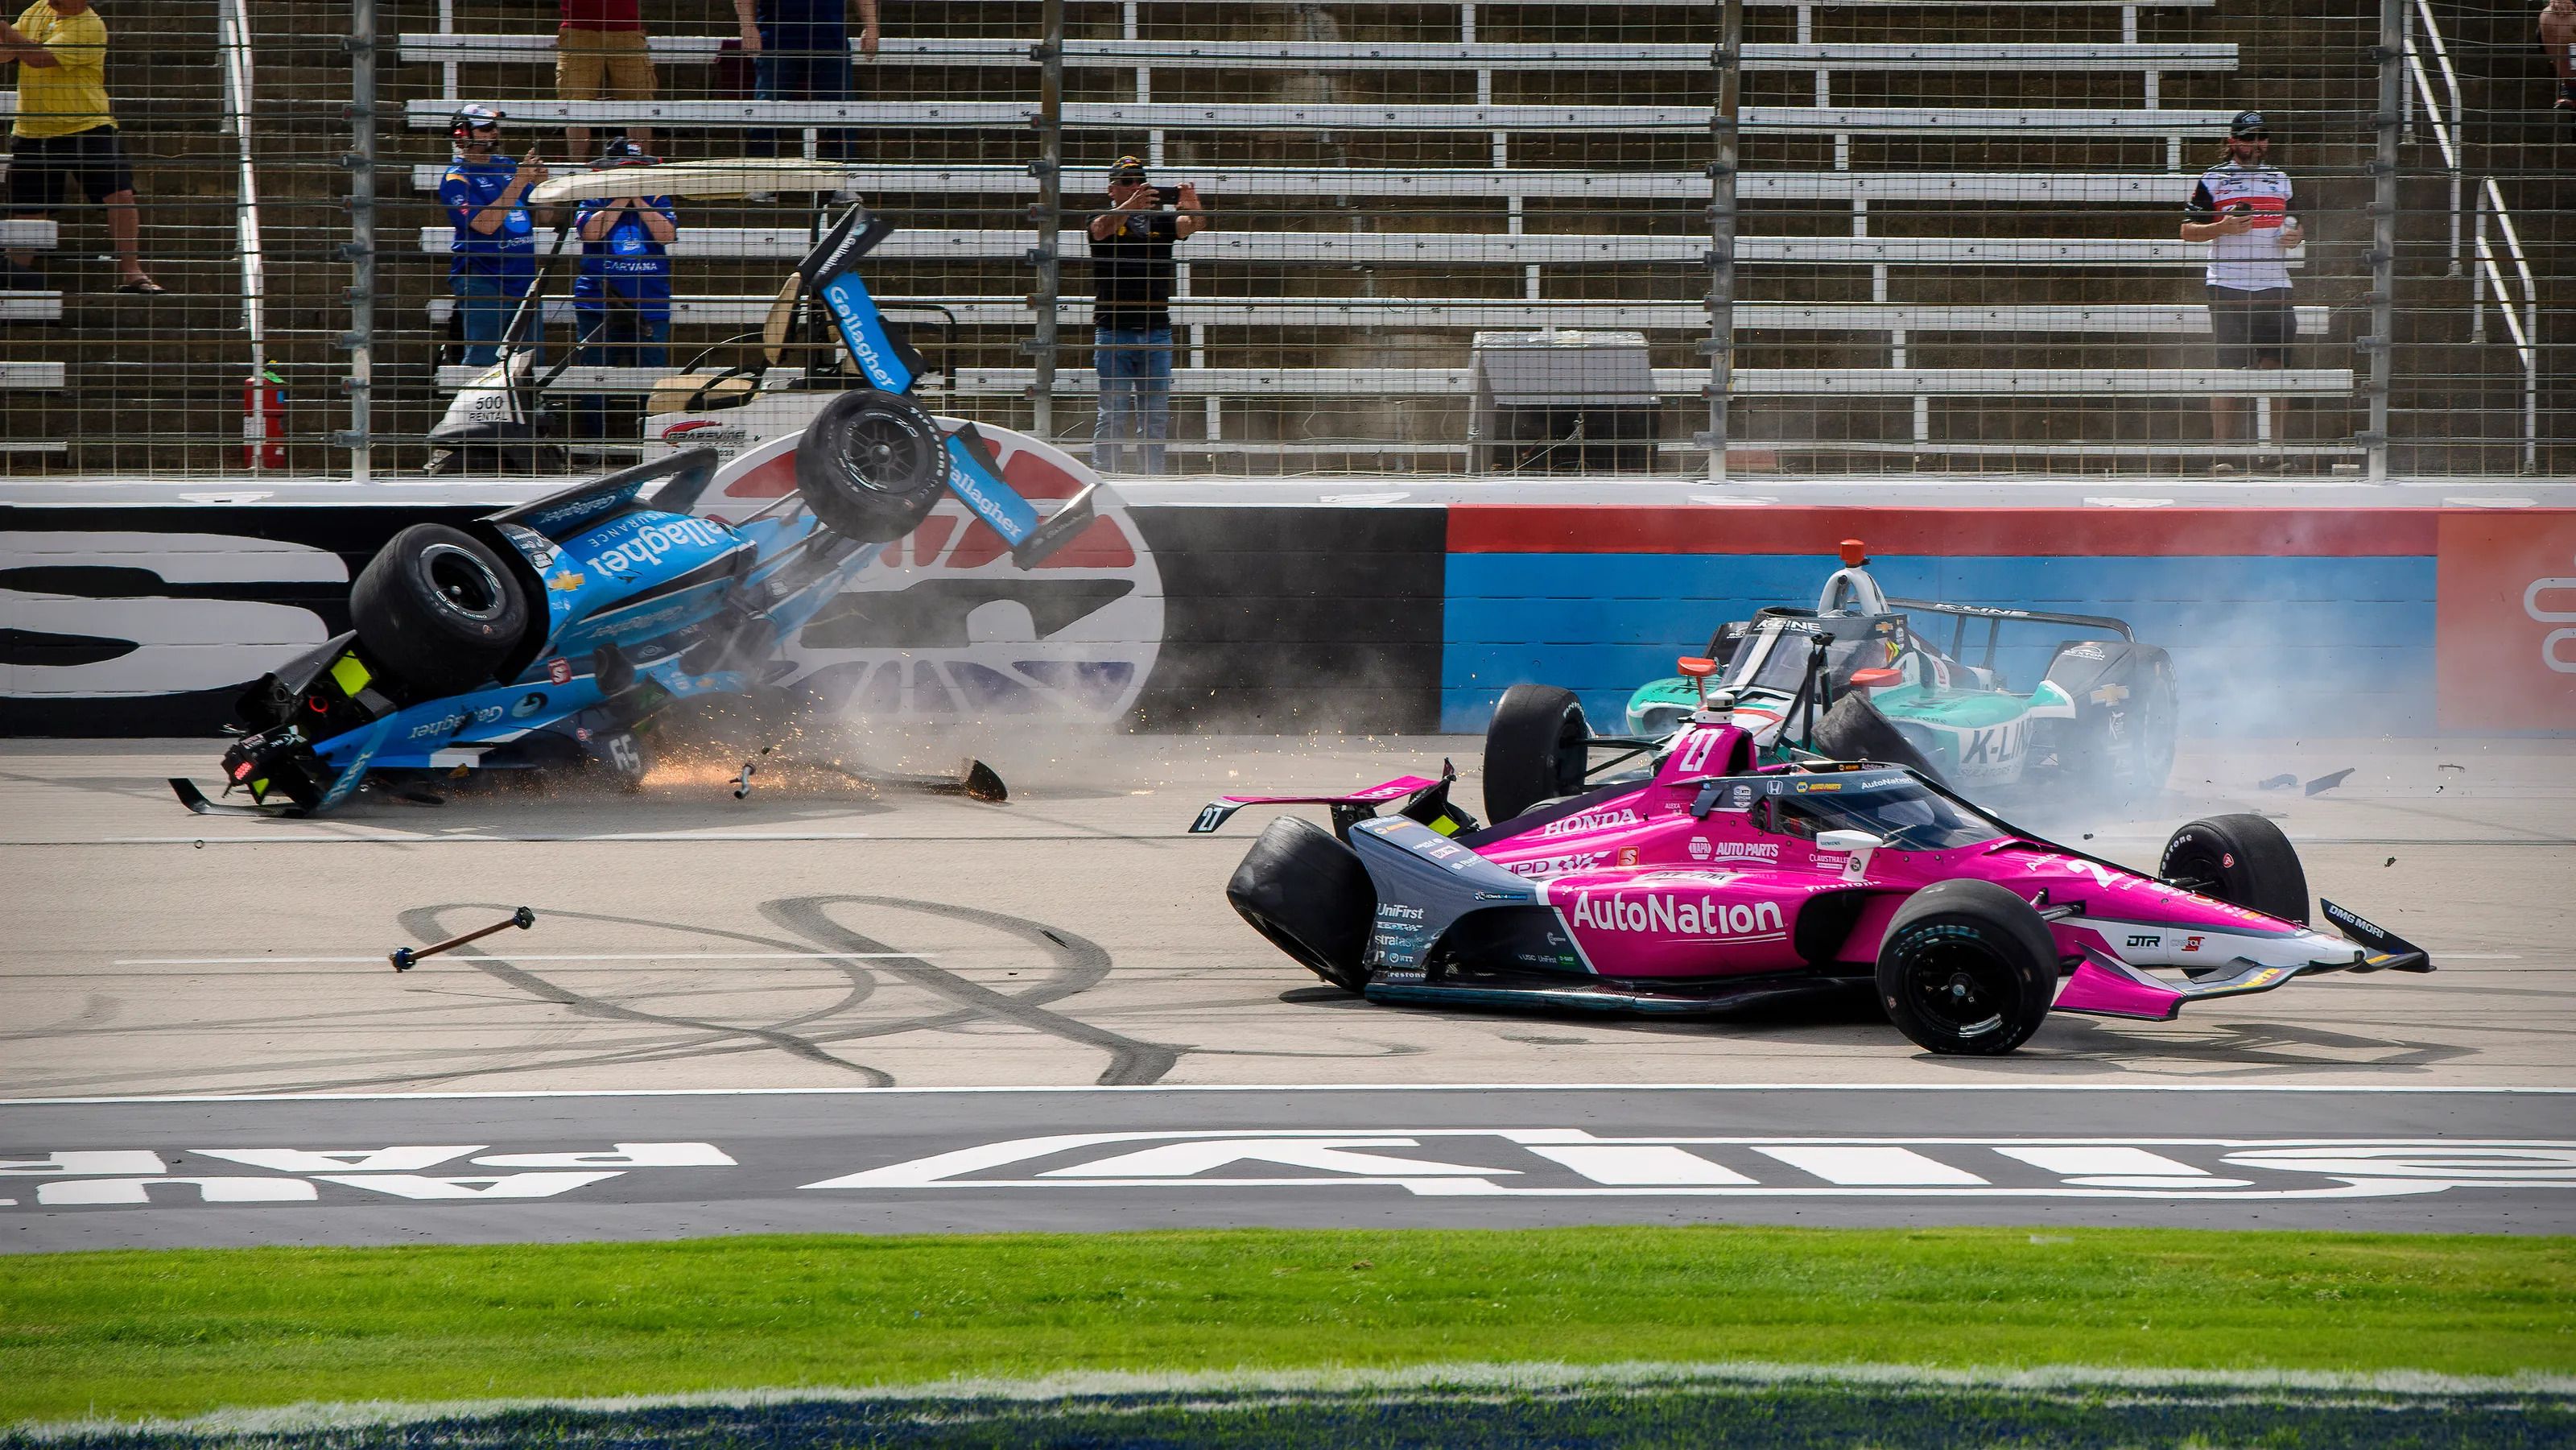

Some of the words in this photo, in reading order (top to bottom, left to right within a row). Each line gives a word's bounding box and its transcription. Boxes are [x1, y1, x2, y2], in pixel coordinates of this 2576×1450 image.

[818, 238, 857, 275] Gallagher
[829, 286, 897, 386] Gallagher
[477, 396, 503, 410] 500
[469, 411, 508, 421] RENTAL
[1678, 728, 1726, 772] 27
[1861, 777, 1913, 790] AutoNation
[1197, 807, 1224, 832] 27
[1542, 808, 1638, 837] HONDA
[1715, 842, 1744, 857] AUTO
[1744, 843, 1779, 857] PARTS
[1377, 903, 1424, 919] UniFirst
[1573, 890, 1785, 935] AutoNation
[2327, 905, 2355, 924] DMG
[2355, 918, 2385, 939] MORI
[2126, 935, 2161, 947] DTR
